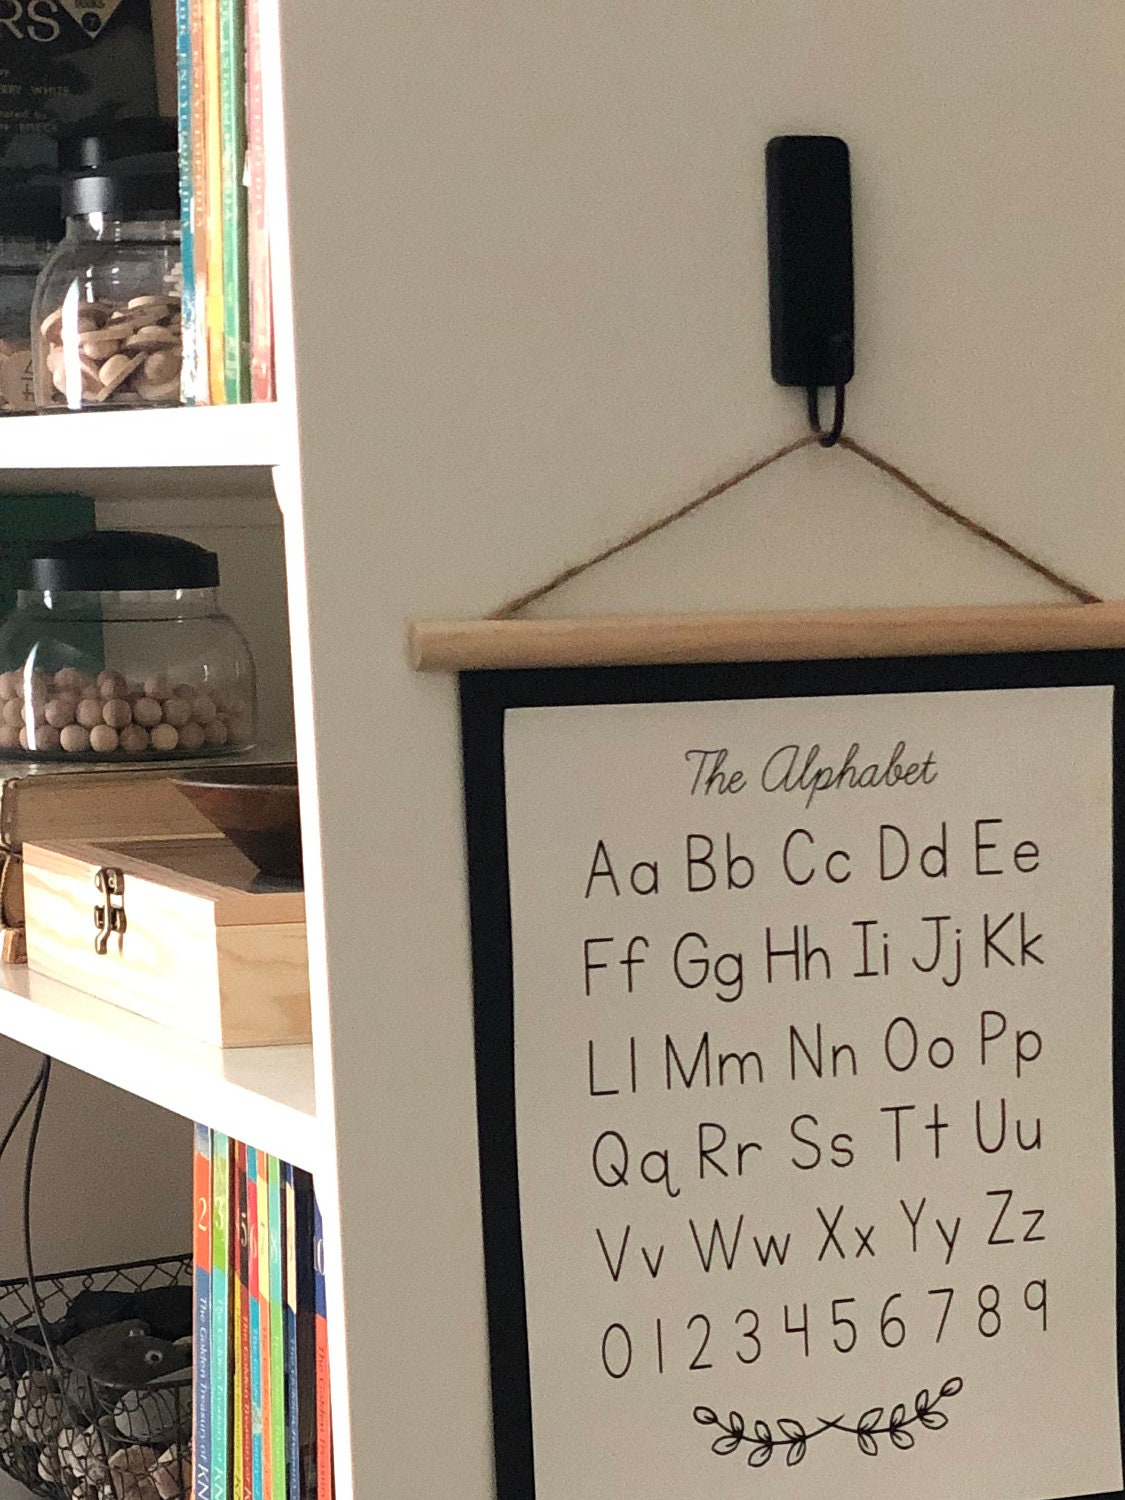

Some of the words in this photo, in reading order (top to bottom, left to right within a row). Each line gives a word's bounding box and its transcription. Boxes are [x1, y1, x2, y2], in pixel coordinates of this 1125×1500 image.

[685, 748, 747, 796] The
[761, 741, 938, 809] Alphabet
[584, 840, 659, 899] Aa
[686, 832, 755, 892] Bb
[783, 829, 851, 886] Cc
[880, 821, 947, 881] Dd
[975, 818, 1039, 875] Ee
[584, 936, 649, 996] Ff
[673, 932, 743, 1003] Gg
[766, 924, 831, 983] Hh
[851, 920, 889, 977] Ii
[912, 916, 961, 987] Jj
[984, 912, 1044, 968] Kk
[589, 1037, 636, 1096] Ll
[665, 1032, 763, 1090] Mm
[790, 1023, 857, 1080] Nn
[885, 1017, 954, 1072] Oo
[981, 1010, 1042, 1079] Pp
[592, 1131, 680, 1198] Qq
[698, 1122, 762, 1179] Rr
[791, 1114, 854, 1170] Ss
[880, 1103, 949, 1162] Tt
[976, 1098, 1041, 1154] Uu
[197, 1197, 207, 1231] 2
[215, 1197, 225, 1231] 3
[240, 1212, 248, 1247] 5
[596, 1225, 664, 1282] Vv
[689, 1214, 791, 1273] Ww
[816, 1205, 875, 1261] Xx
[899, 1197, 961, 1265] Yy
[986, 1189, 1045, 1245] Zz
[199, 1297, 208, 1322] The
[216, 1299, 225, 1322] The
[242, 1316, 250, 1340] The
[199, 1326, 208, 1379] Golden
[216, 1328, 225, 1380] Golden
[243, 1346, 251, 1398] Golden
[317, 1346, 326, 1374] The
[198, 1382, 208, 1440] Treasury
[216, 1384, 225, 1441] Treasury
[243, 1402, 252, 1460] Treasury
[318, 1378, 327, 1433] Golden
[199, 1444, 208, 1461] of
[216, 1446, 225, 1462] of
[319, 1437, 328, 1499] Treasury
